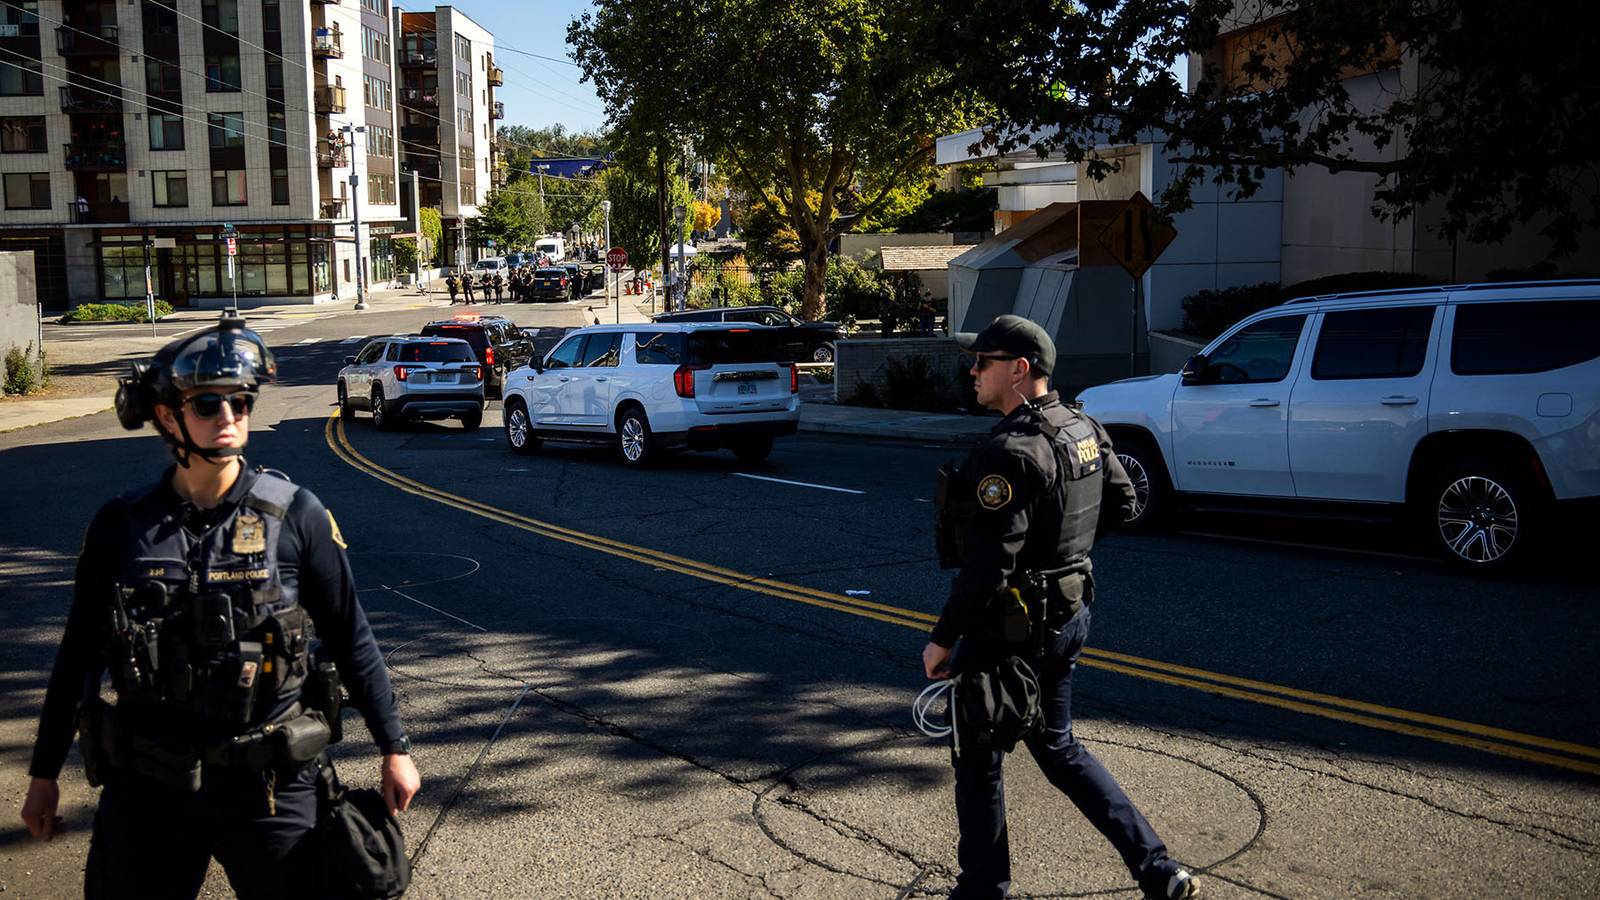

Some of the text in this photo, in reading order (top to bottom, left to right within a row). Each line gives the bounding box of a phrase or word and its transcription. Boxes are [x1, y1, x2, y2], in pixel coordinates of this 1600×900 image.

[608, 254, 626, 262] STOP
[1077, 444, 1100, 464] POLICE
[208, 569, 270, 580] PORTLAND POLICE
